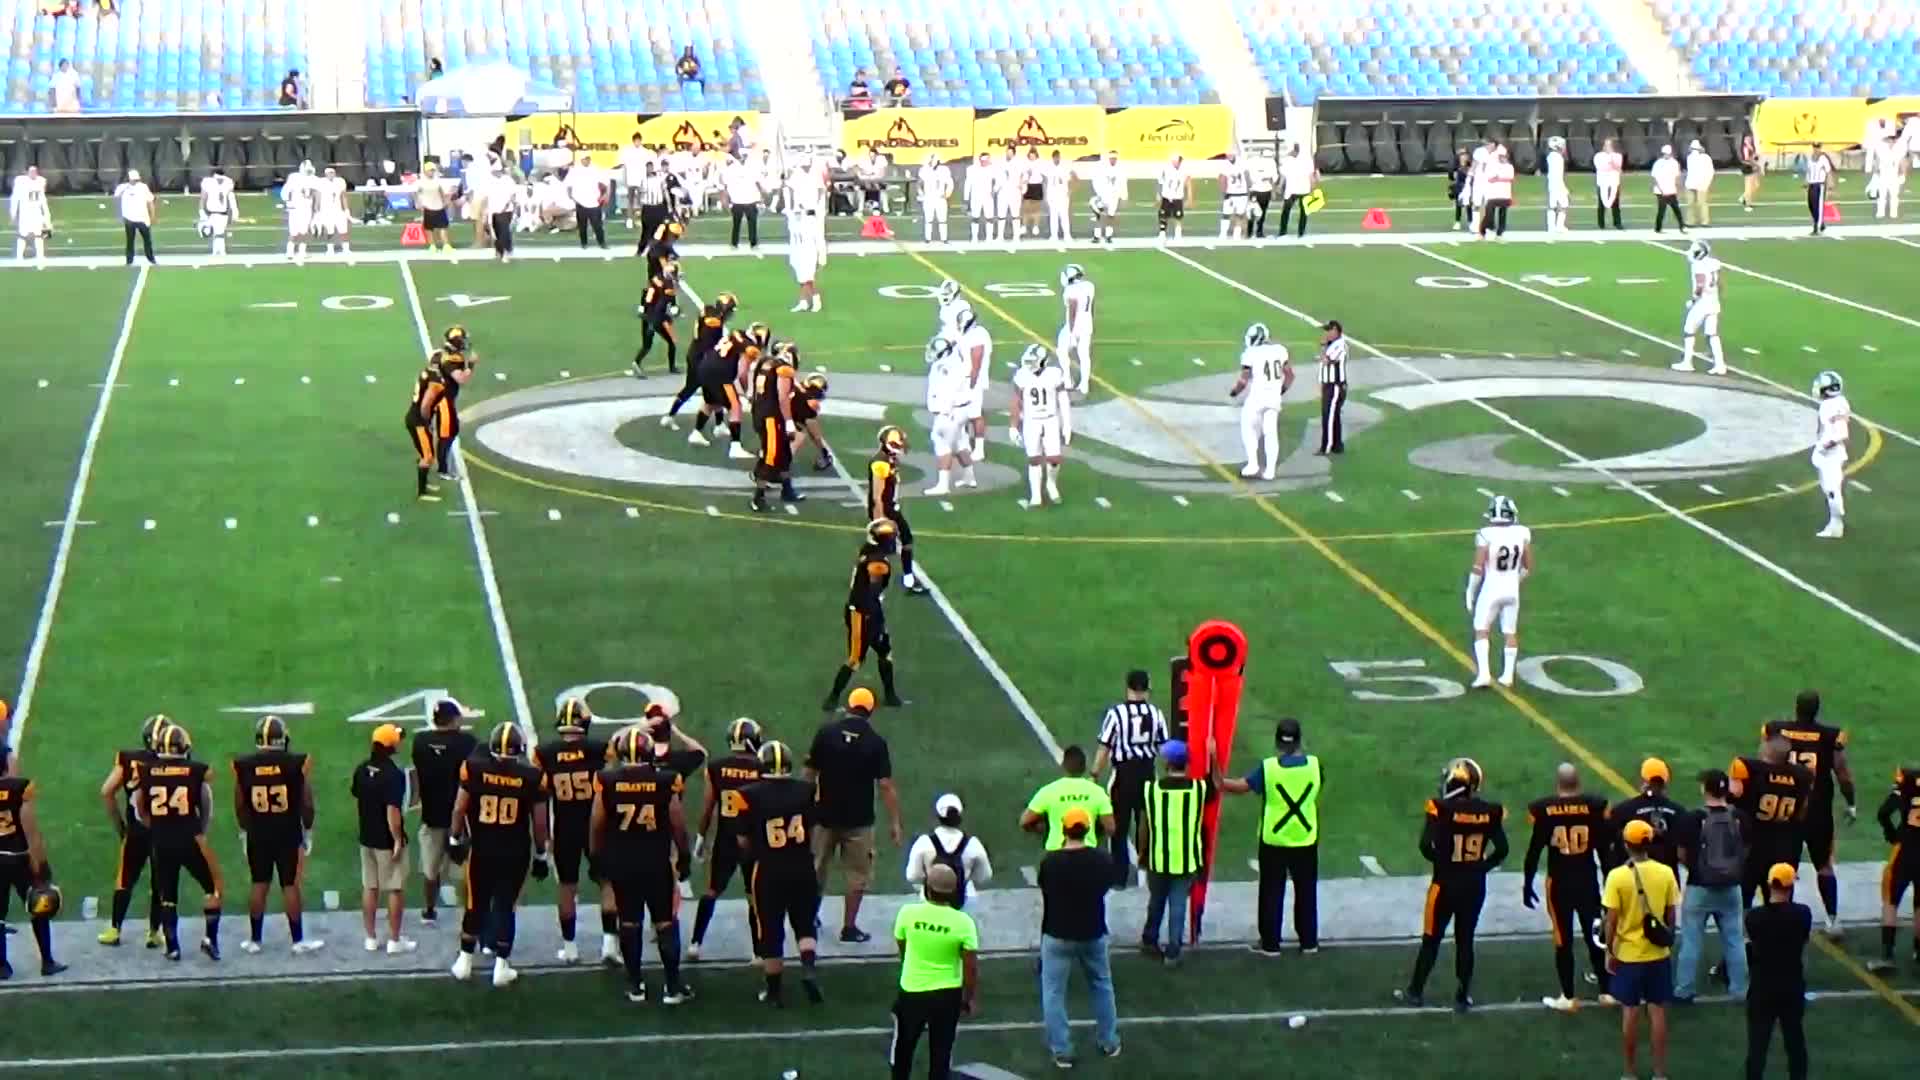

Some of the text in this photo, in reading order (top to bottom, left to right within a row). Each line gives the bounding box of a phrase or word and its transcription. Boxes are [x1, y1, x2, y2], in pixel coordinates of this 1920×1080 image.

[1262, 359, 1284, 382] 40
[1030, 386, 1048, 406] 91
[1496, 545, 1520, 572] 21
[1131, 715, 1150, 744] L
[251, 785, 289, 813] 83
[553, 770, 593, 801] 85
[150, 785, 190, 816] 24
[479, 794, 519, 825] 80
[1757, 793, 1797, 822] 90
[616, 803, 657, 832] 74
[766, 813, 806, 849] 64
[1451, 832, 1484, 863] 19
[1551, 825, 1590, 856] 40
[914, 921, 951, 934] STAFF
